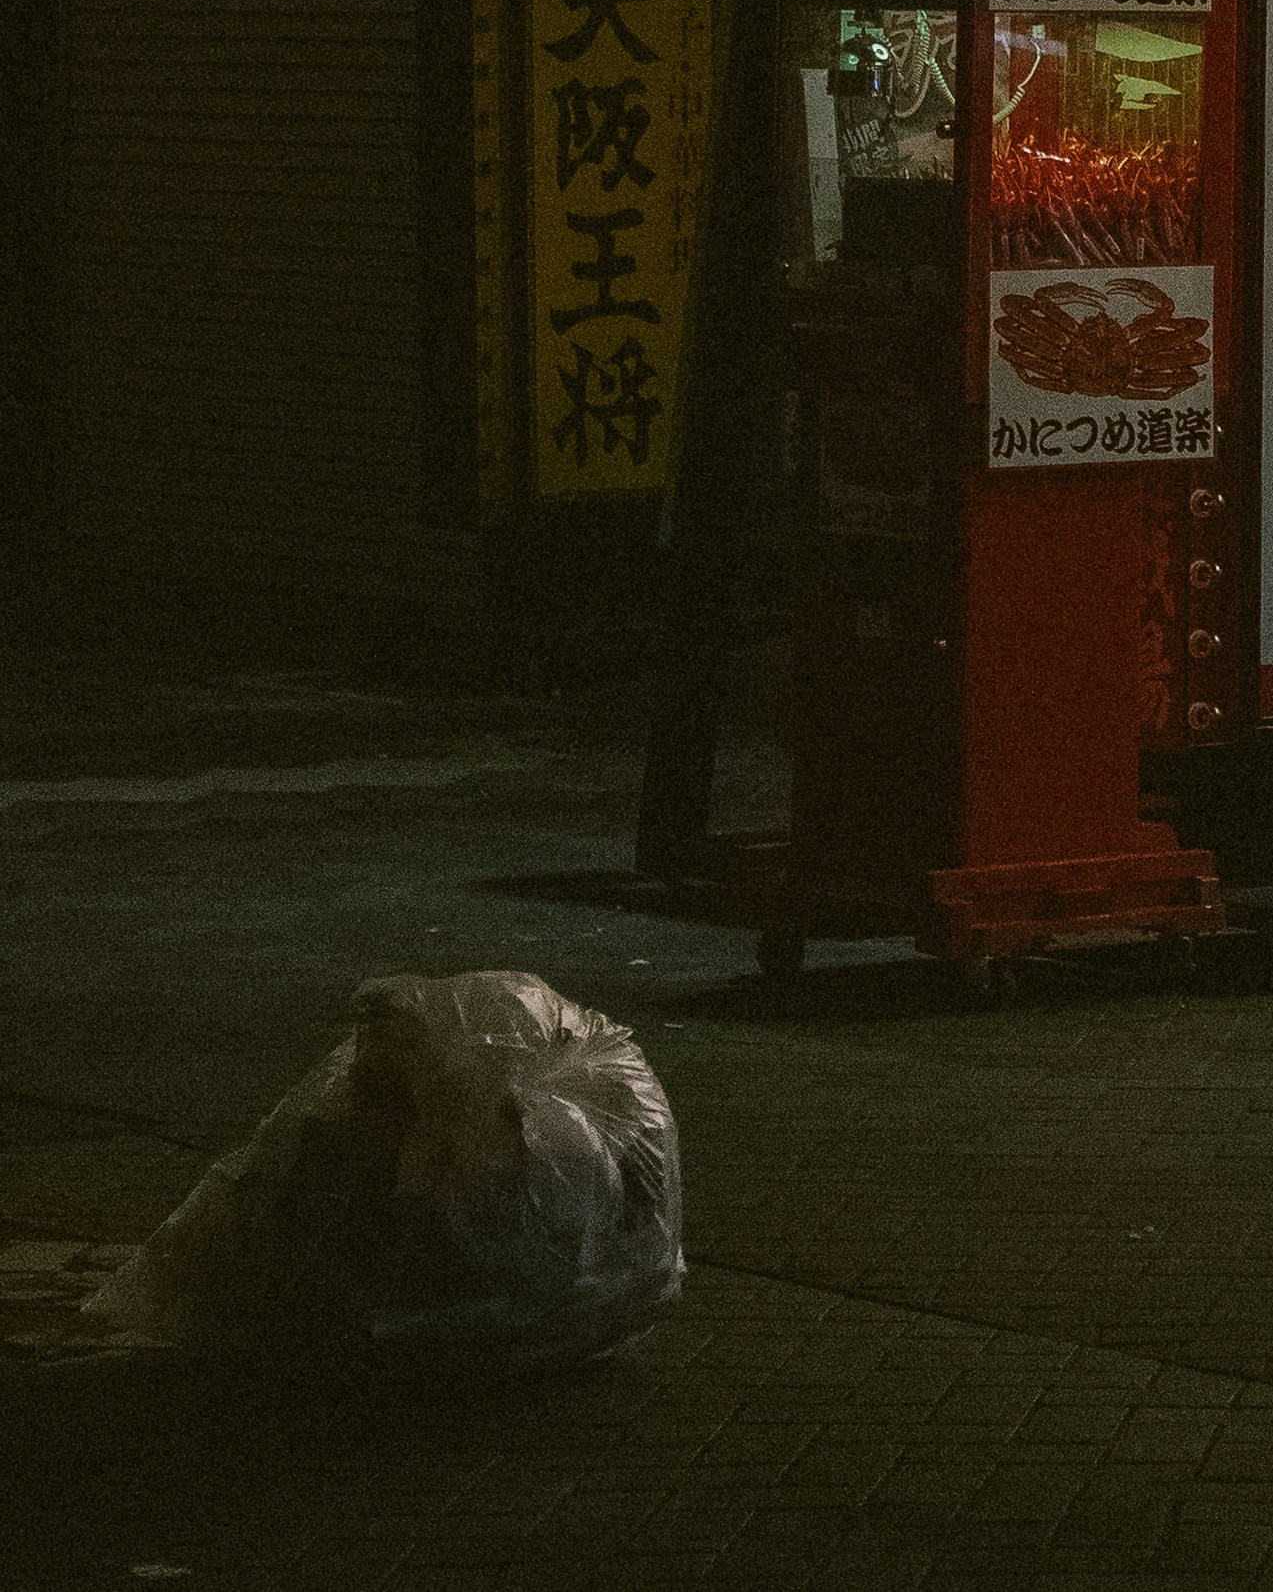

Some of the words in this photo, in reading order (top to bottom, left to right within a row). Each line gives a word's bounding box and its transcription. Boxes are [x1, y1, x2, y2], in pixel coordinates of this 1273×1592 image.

[991, 406, 1212, 460] かにつめ道楽
